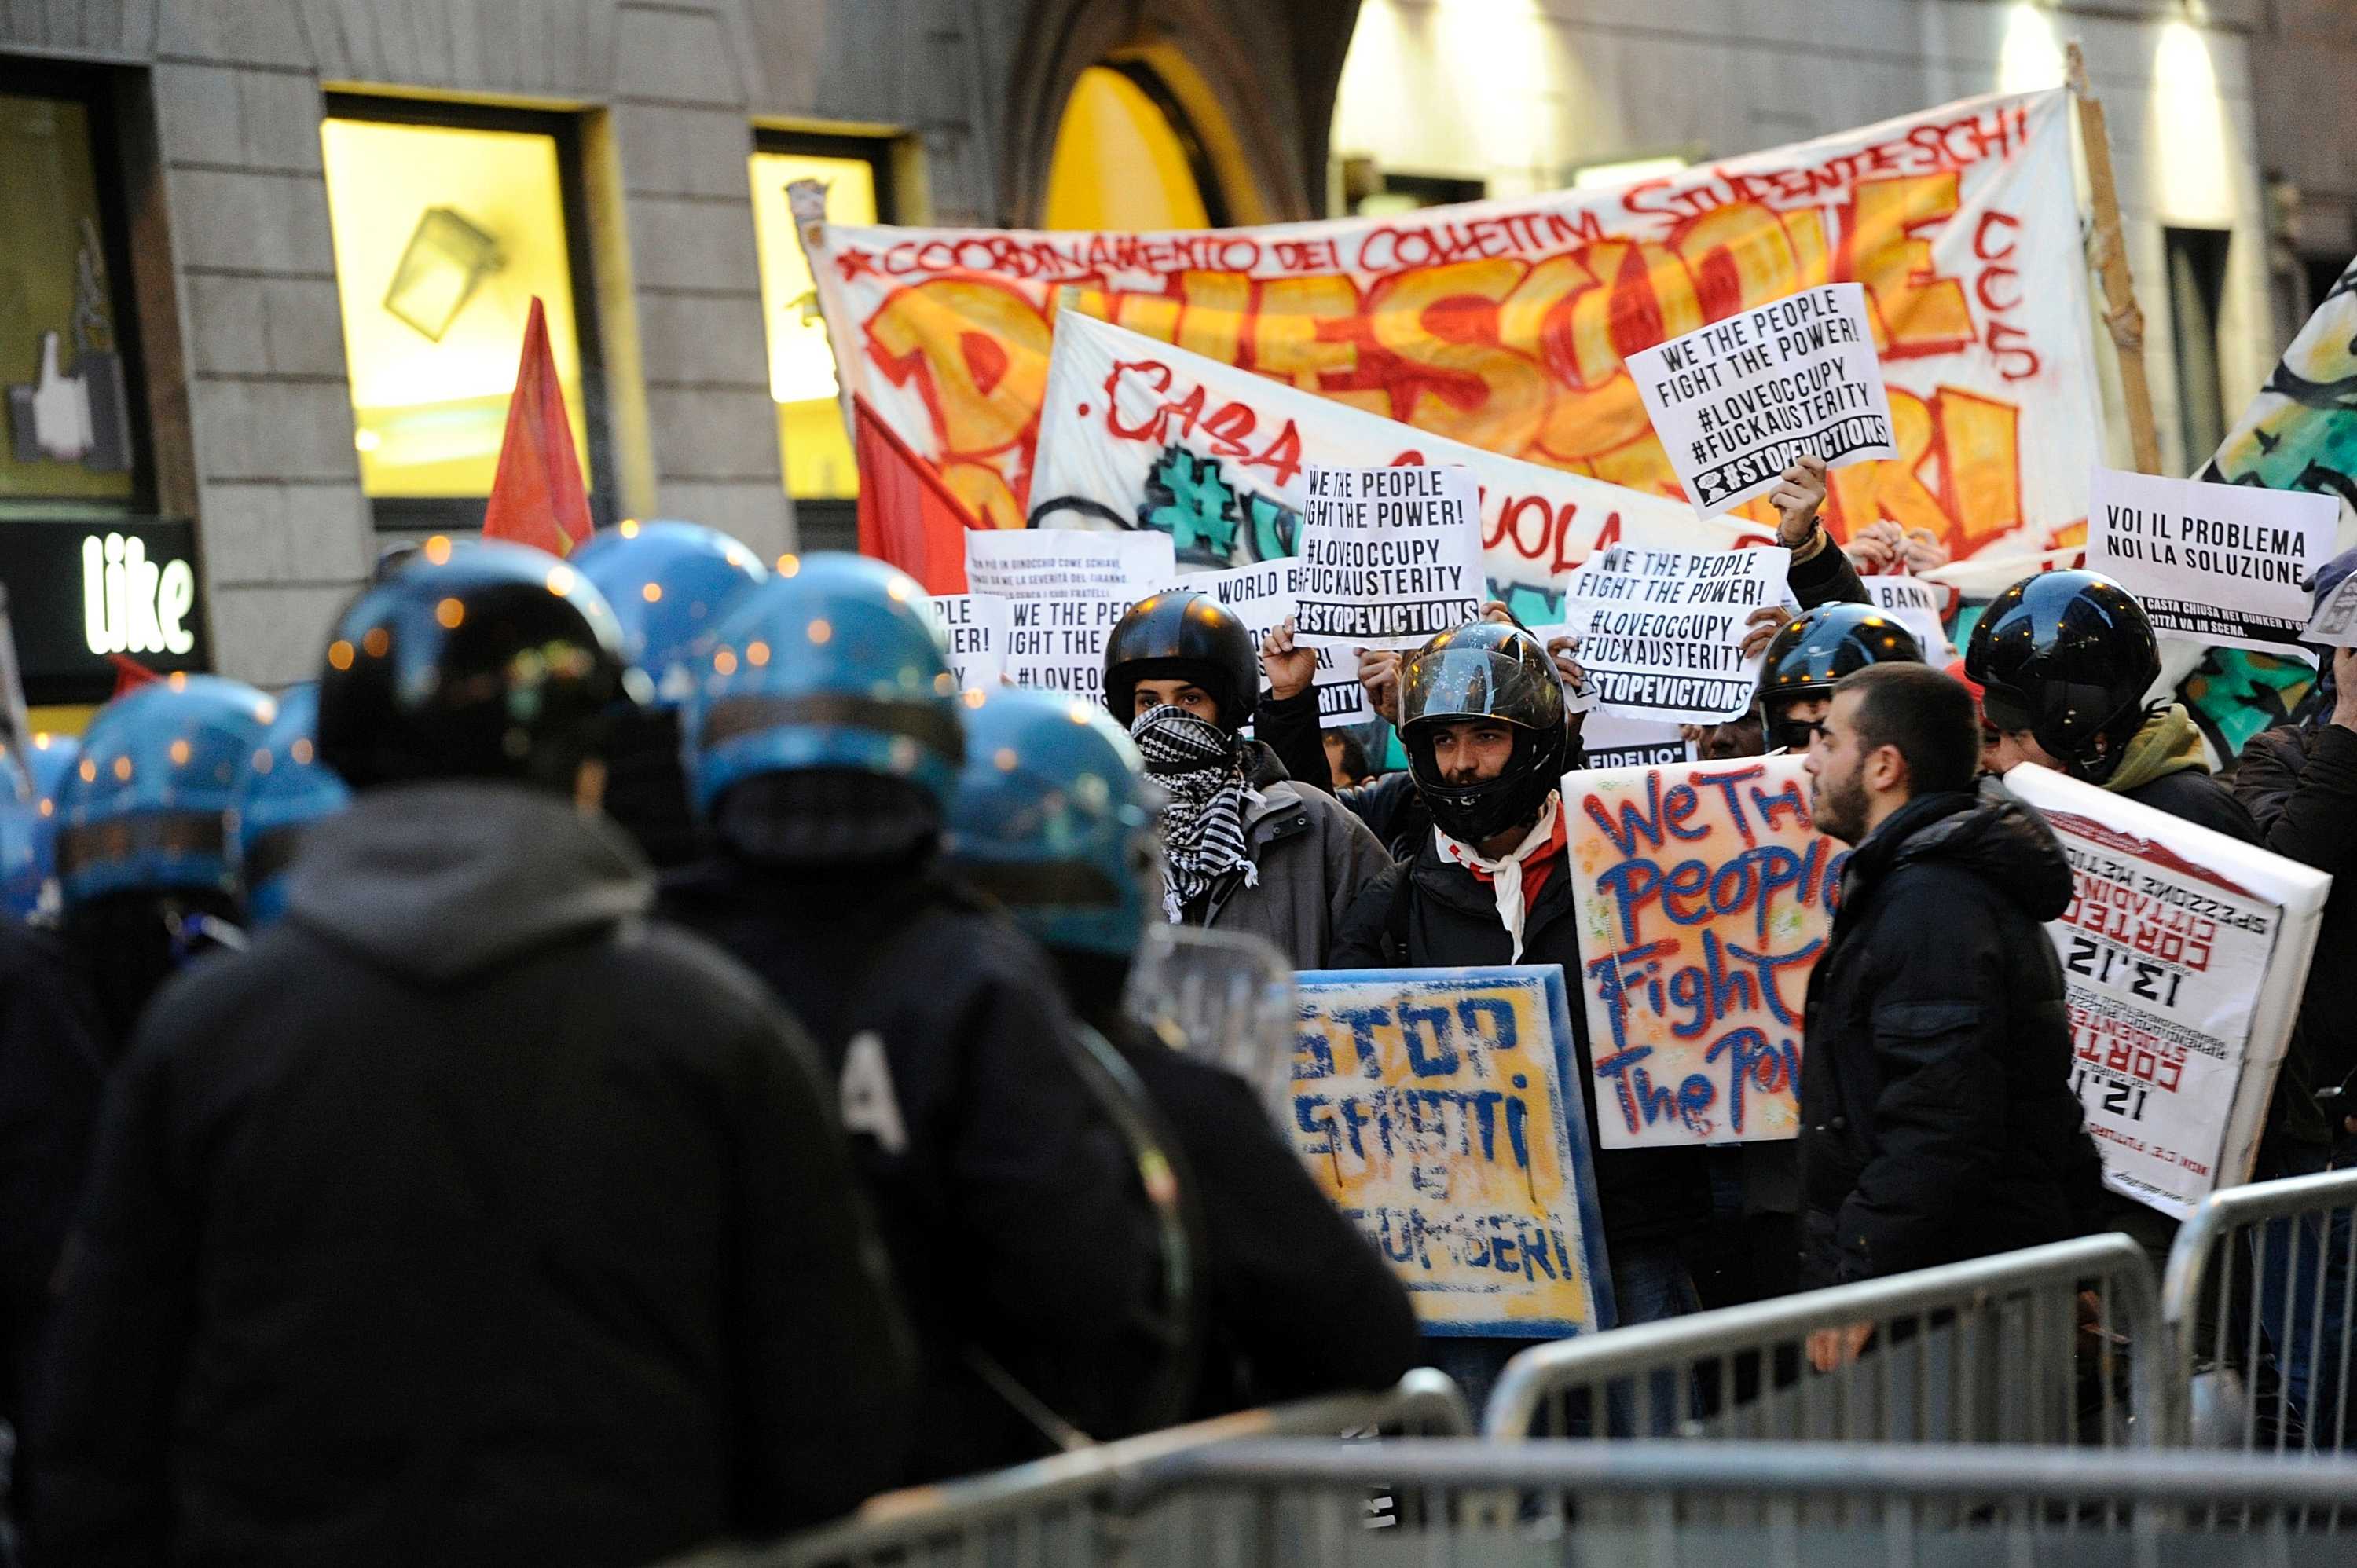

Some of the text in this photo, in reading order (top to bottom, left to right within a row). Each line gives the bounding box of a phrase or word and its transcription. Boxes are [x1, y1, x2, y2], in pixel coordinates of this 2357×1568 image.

[1274, 238, 1340, 271] DEI
[1660, 289, 1838, 373] WE THE PEOPLE
[1655, 317, 1860, 408] FIGHT THE POWER!
[1697, 356, 1847, 434] #LOVEOCCUPY
[1692, 382, 1871, 465] #FUCKAUSTERITY
[1310, 470, 1443, 497] WE THE PEOPLE
[1303, 500, 1464, 528] IGHT THE POWER!
[2106, 504, 2305, 558] VOI IL PROBLEMA
[1307, 539, 1440, 567] #LOVEOCCUPY
[1603, 548, 1758, 579] WE THE PEOPLE
[2107, 534, 2304, 586] NOI LA SOLUZIONE
[82, 532, 194, 654] like
[1218, 571, 1277, 604] WORLD
[1299, 566, 1462, 596] #FUCKAUSTERITY
[1577, 573, 1765, 606] FIGHT THE POWER!
[1014, 603, 1041, 626] WE
[1050, 602, 1087, 625] THE
[1300, 600, 1479, 635] #STOPEVICTIONS
[1590, 610, 1734, 642] #LOVEOCCUPY
[2147, 598, 2180, 613] CASTA
[2183, 602, 2220, 618] CHIUSA
[2222, 608, 2240, 621] NEI
[2242, 612, 2282, 629] BUNKER
[2179, 617, 2194, 631] VA
[2197, 619, 2209, 632] IN
[2211, 621, 2249, 638] SCENA.
[1008, 631, 1053, 654] IGHT
[1062, 630, 1101, 654] THE
[1319, 683, 1362, 718] RITY
[1588, 670, 1751, 713] STOPEVICTIONS
[2066, 936, 2183, 1009] 13.12
[2067, 1065, 2147, 1122] 12.1
